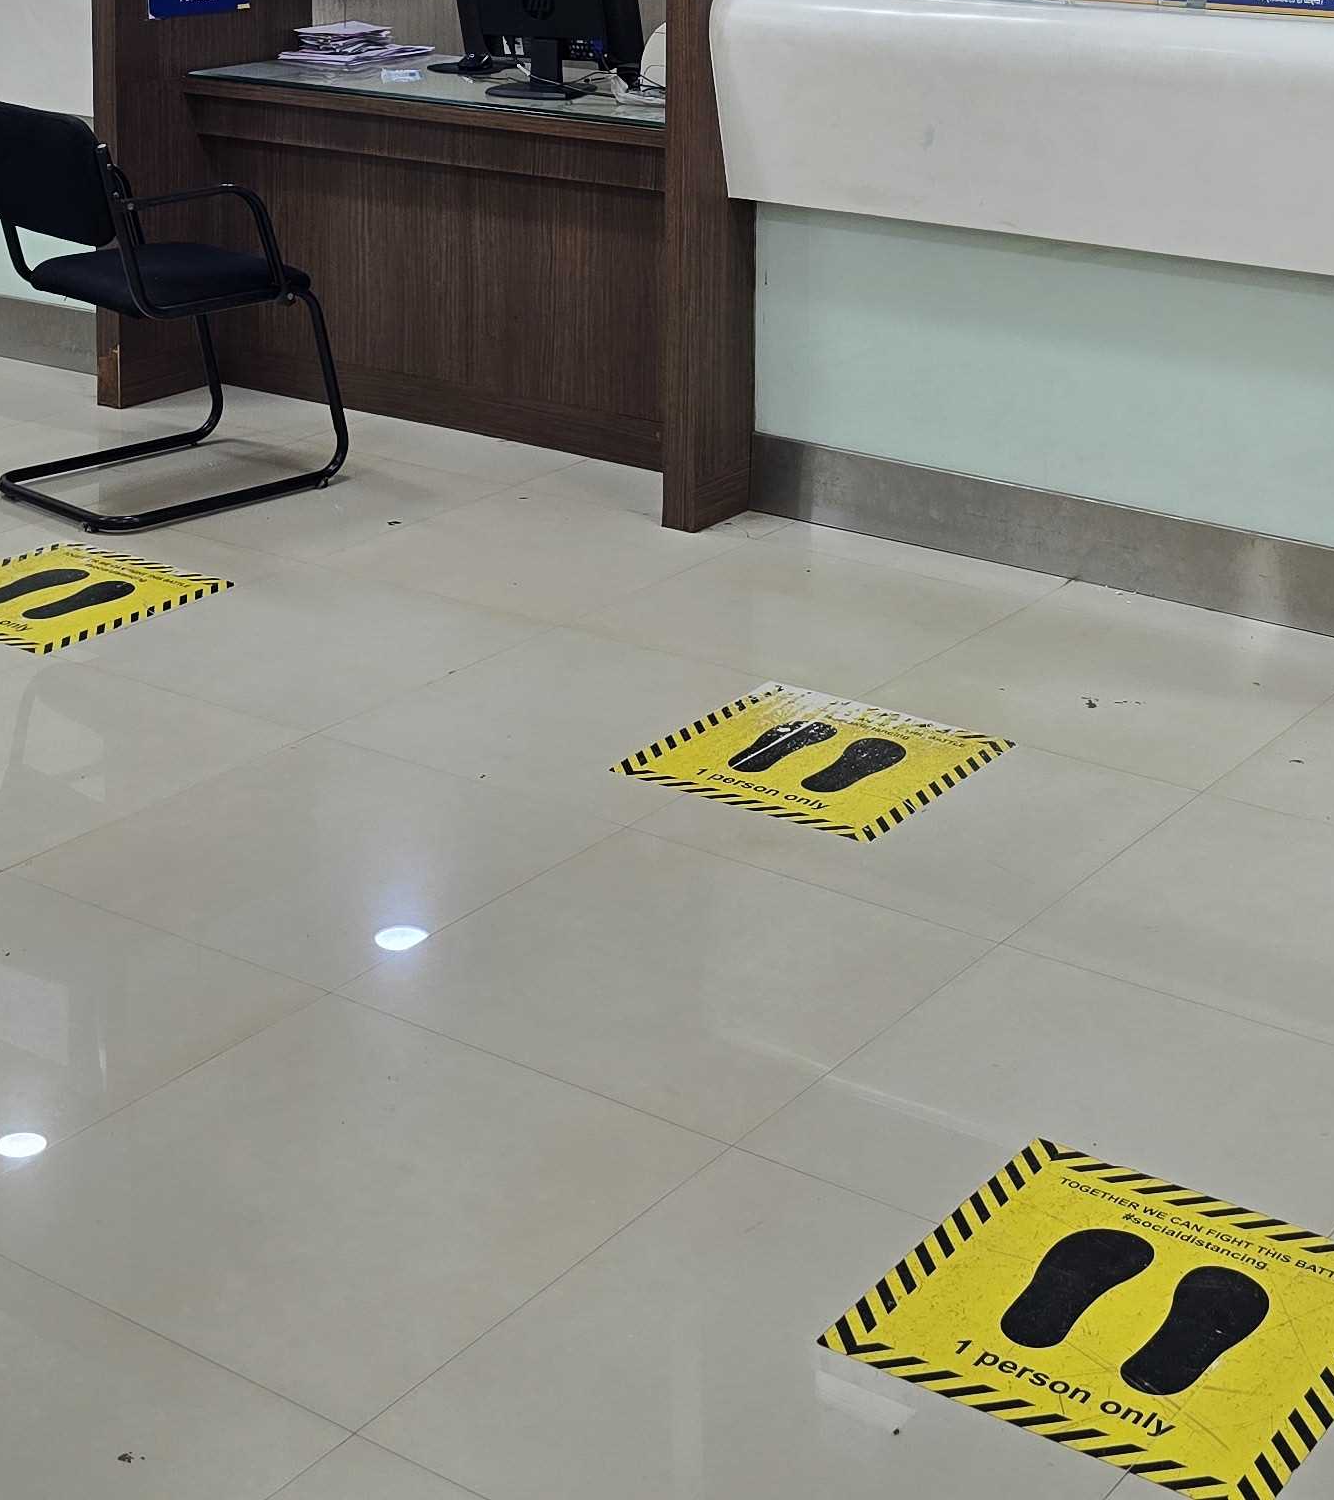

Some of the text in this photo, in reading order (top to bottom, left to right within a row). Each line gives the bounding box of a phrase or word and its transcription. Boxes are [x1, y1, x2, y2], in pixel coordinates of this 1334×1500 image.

[695, 768, 831, 811] 1 person only
[1060, 1176, 1138, 1211] TOGETHER
[1141, 1207, 1169, 1221] WE
[1170, 1216, 1204, 1234] CAN
[1206, 1228, 1255, 1251] FIGHT
[1257, 1246, 1293, 1264] THIS
[1121, 1213, 1269, 1271] #socialdistancing
[955, 1339, 1176, 1438] 1 person only
